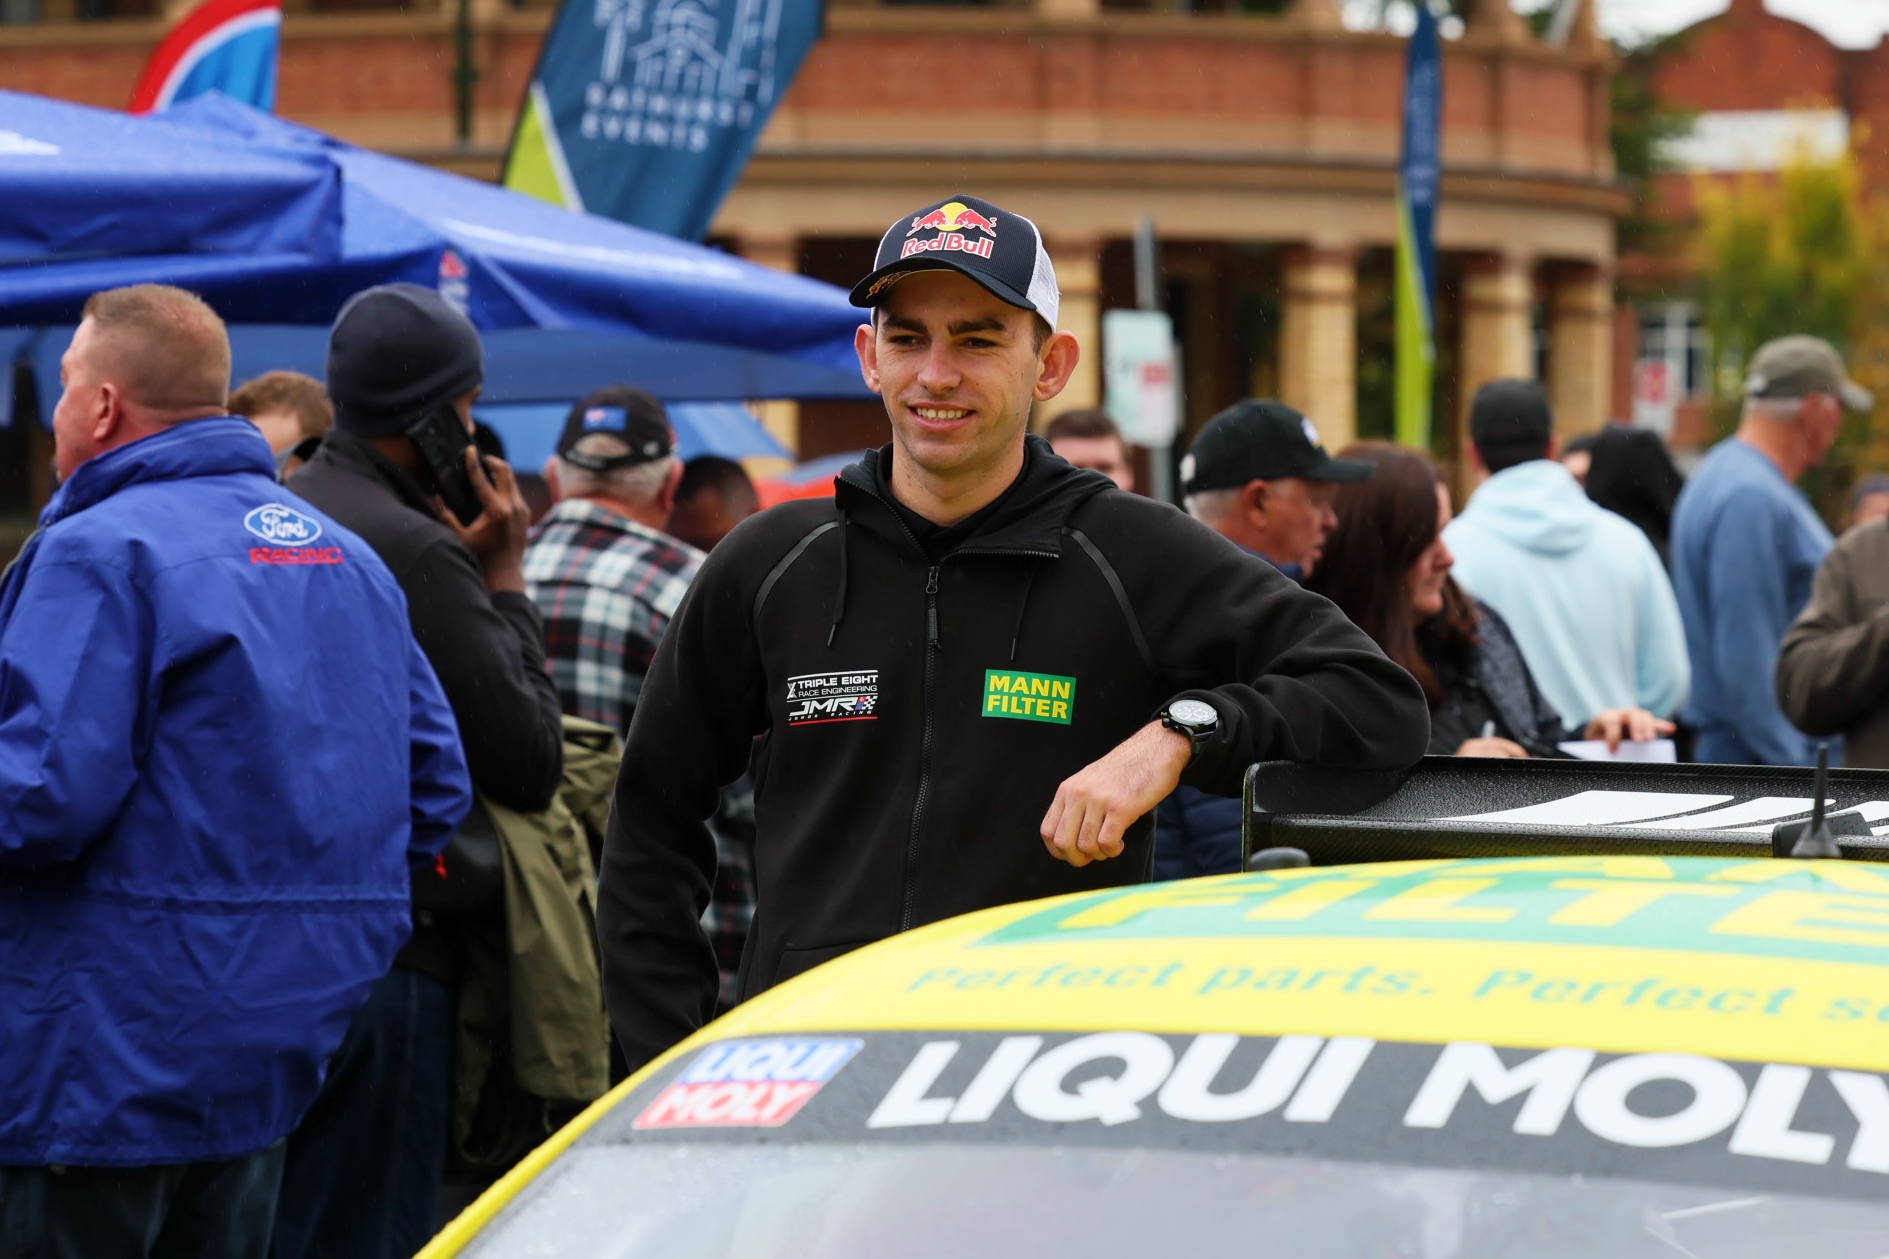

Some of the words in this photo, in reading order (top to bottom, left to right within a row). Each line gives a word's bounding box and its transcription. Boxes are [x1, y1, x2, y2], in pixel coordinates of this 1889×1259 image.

[580, 112, 708, 153] EVENTS
[901, 232, 945, 259] Red
[944, 232, 995, 259] Bull
[260, 508, 309, 538] Ford
[798, 678, 838, 689] TRIPLE
[841, 675, 878, 685] EIGHT
[798, 689, 820, 697] RACE
[821, 685, 877, 695] ENGINEERING
[989, 675, 1071, 699] MANN
[789, 697, 859, 716] JMR
[987, 695, 1068, 719] FILTER
[907, 961, 1187, 992] Perfect
[1197, 963, 1434, 996] parts.
[1472, 969, 1796, 1018] Perfect
[685, 1041, 854, 1082] LIQUI
[866, 1031, 1377, 1129] LIQUI
[649, 1082, 814, 1123] MOLY
